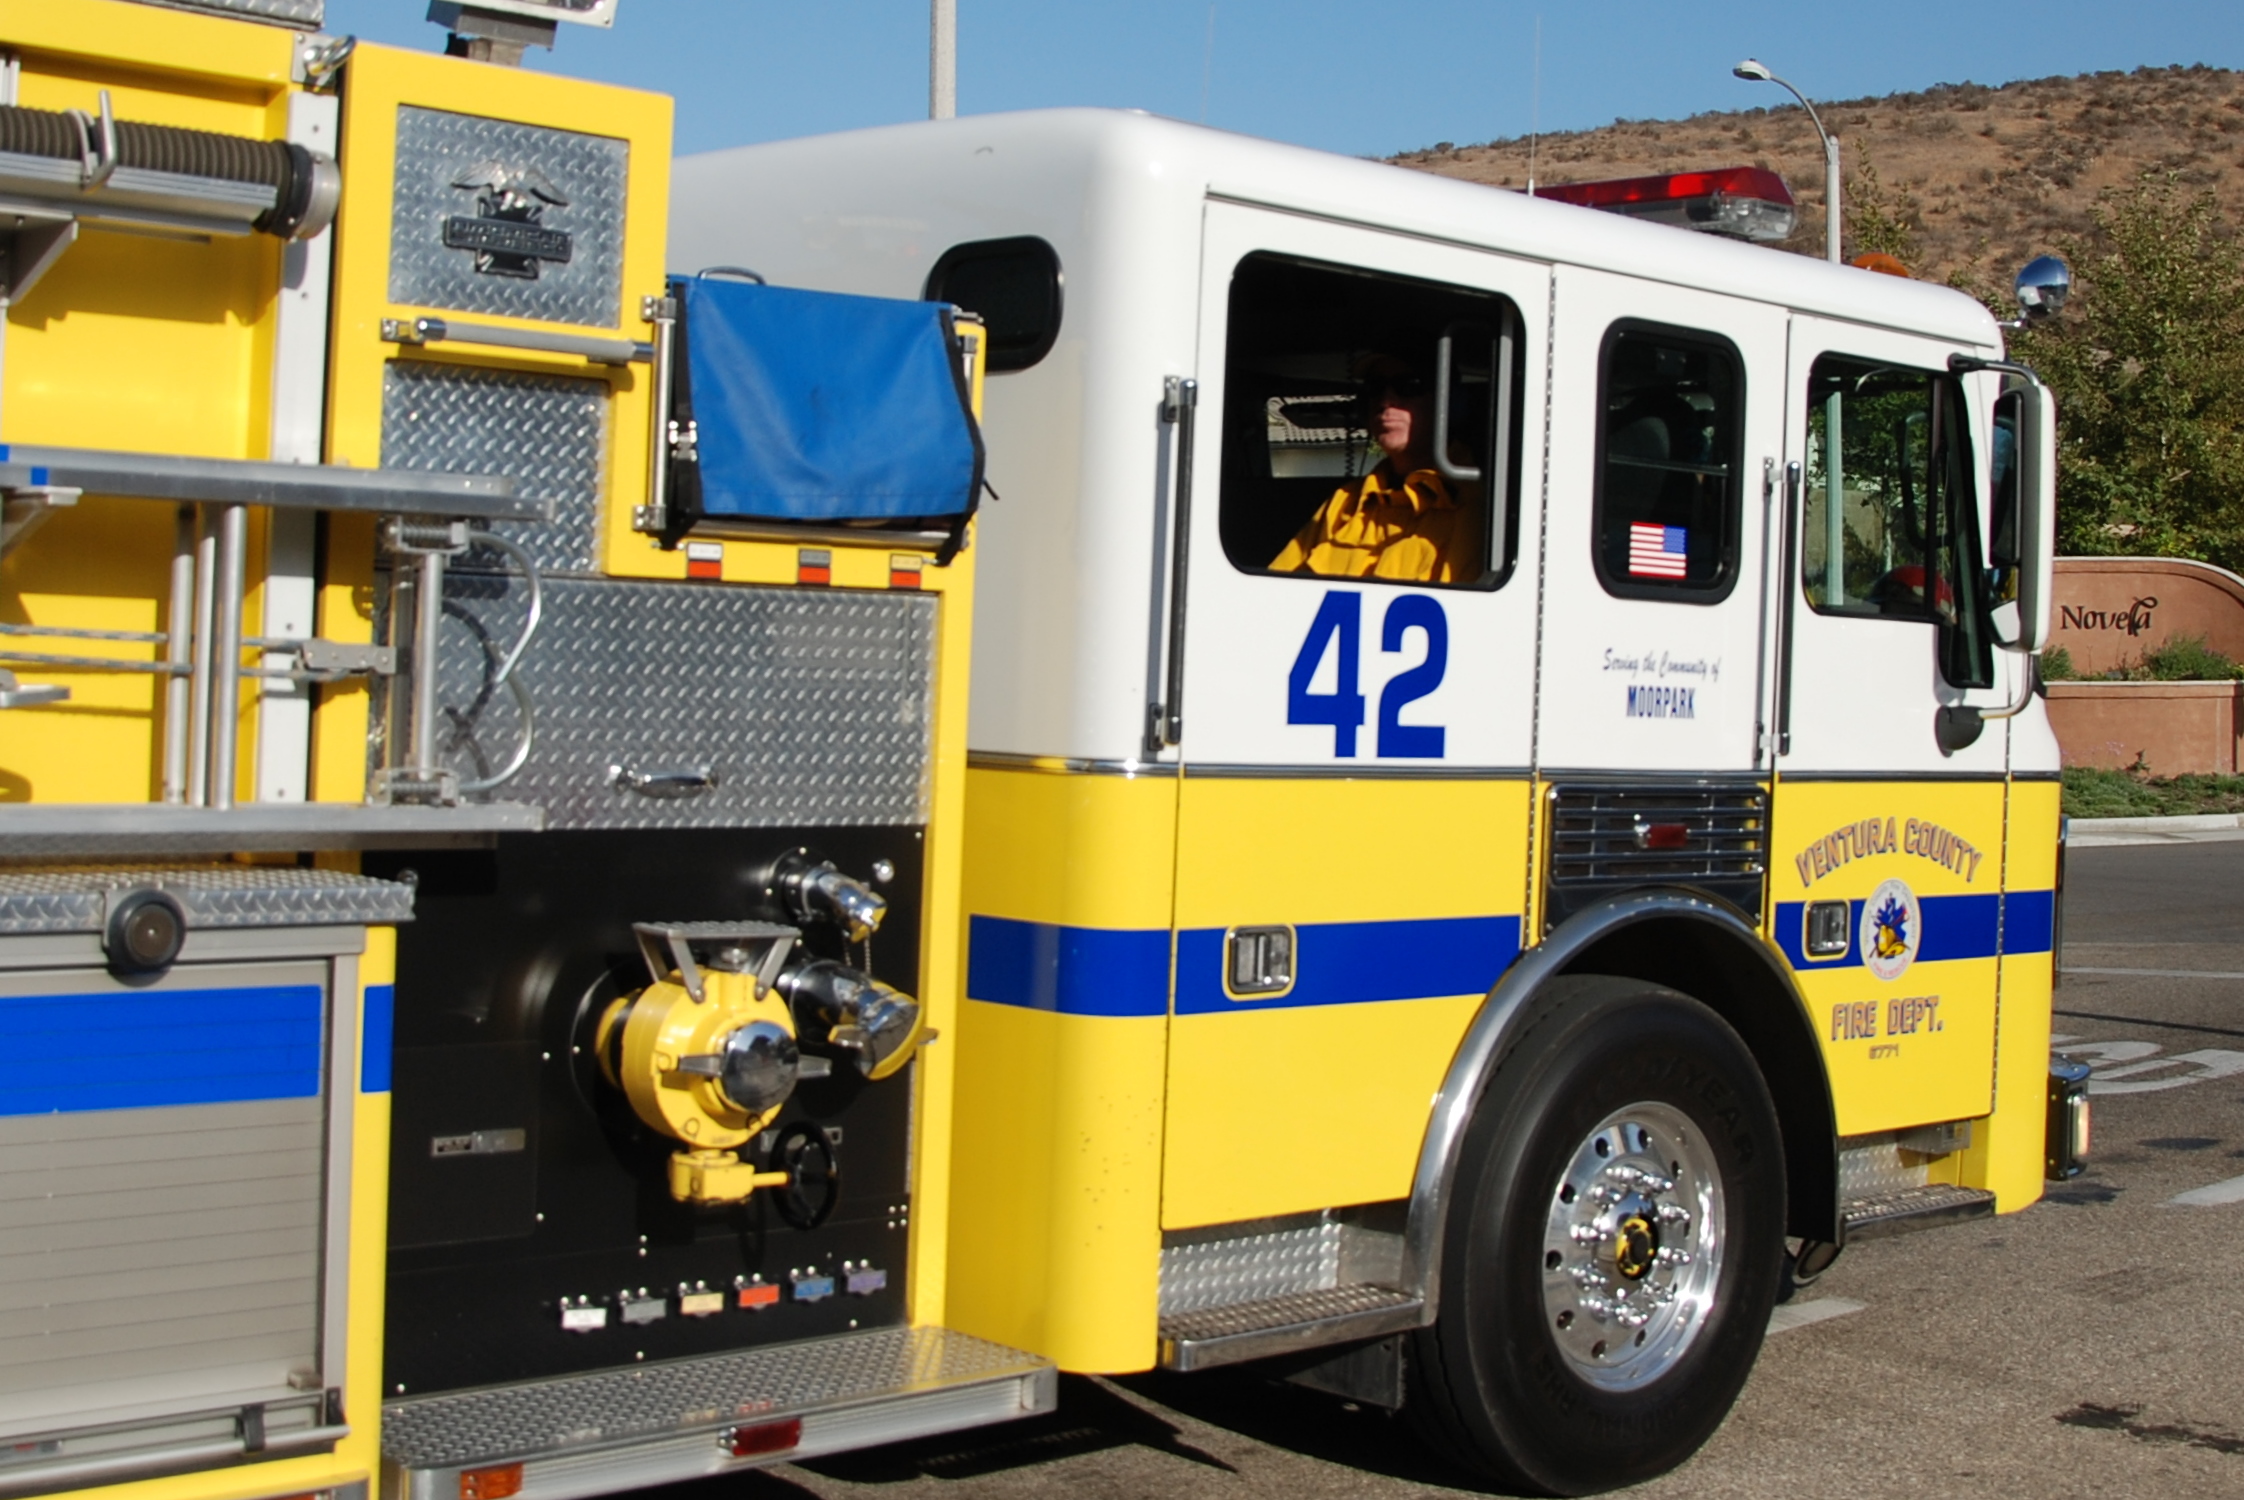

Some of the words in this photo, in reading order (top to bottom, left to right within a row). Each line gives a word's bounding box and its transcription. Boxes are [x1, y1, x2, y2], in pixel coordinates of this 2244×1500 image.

[2060, 596, 2158, 637] Novella
[1287, 590, 1448, 758] 42
[1602, 648, 1639, 678] Serving
[1643, 650, 1656, 673] the
[1626, 685, 1695, 720] MOORPARK
[1795, 817, 1897, 888] VENTURA
[1903, 817, 1983, 883] COUNTY
[1831, 1000, 1877, 1041] FIRE
[1887, 995, 1944, 1036] DEPT.
